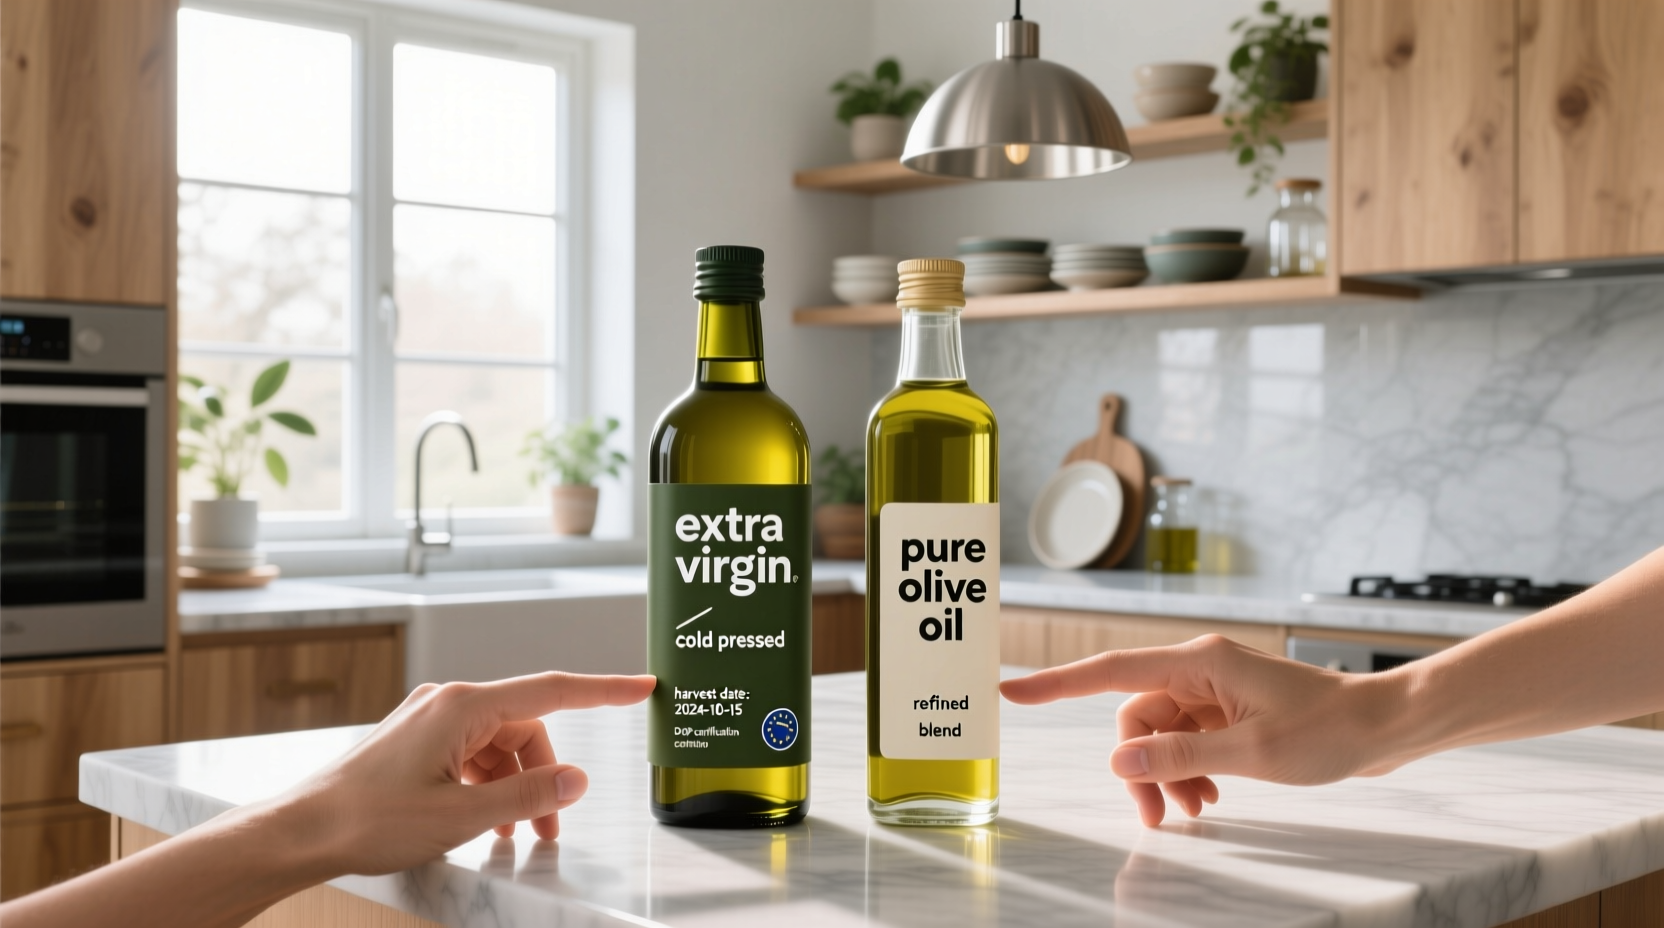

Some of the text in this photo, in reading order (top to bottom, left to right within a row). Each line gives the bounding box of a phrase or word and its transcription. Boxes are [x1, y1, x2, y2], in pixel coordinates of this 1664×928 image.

[675, 508, 783, 542] extra
[902, 538, 986, 572] pure
[899, 569, 987, 603] olive
[919, 608, 963, 641] oil
[675, 630, 785, 653] cold pressed
[674, 686, 750, 700] harvest date:
[913, 694, 969, 711] refined
[674, 702, 743, 717] 2024-10-15
[919, 722, 962, 738] blend
